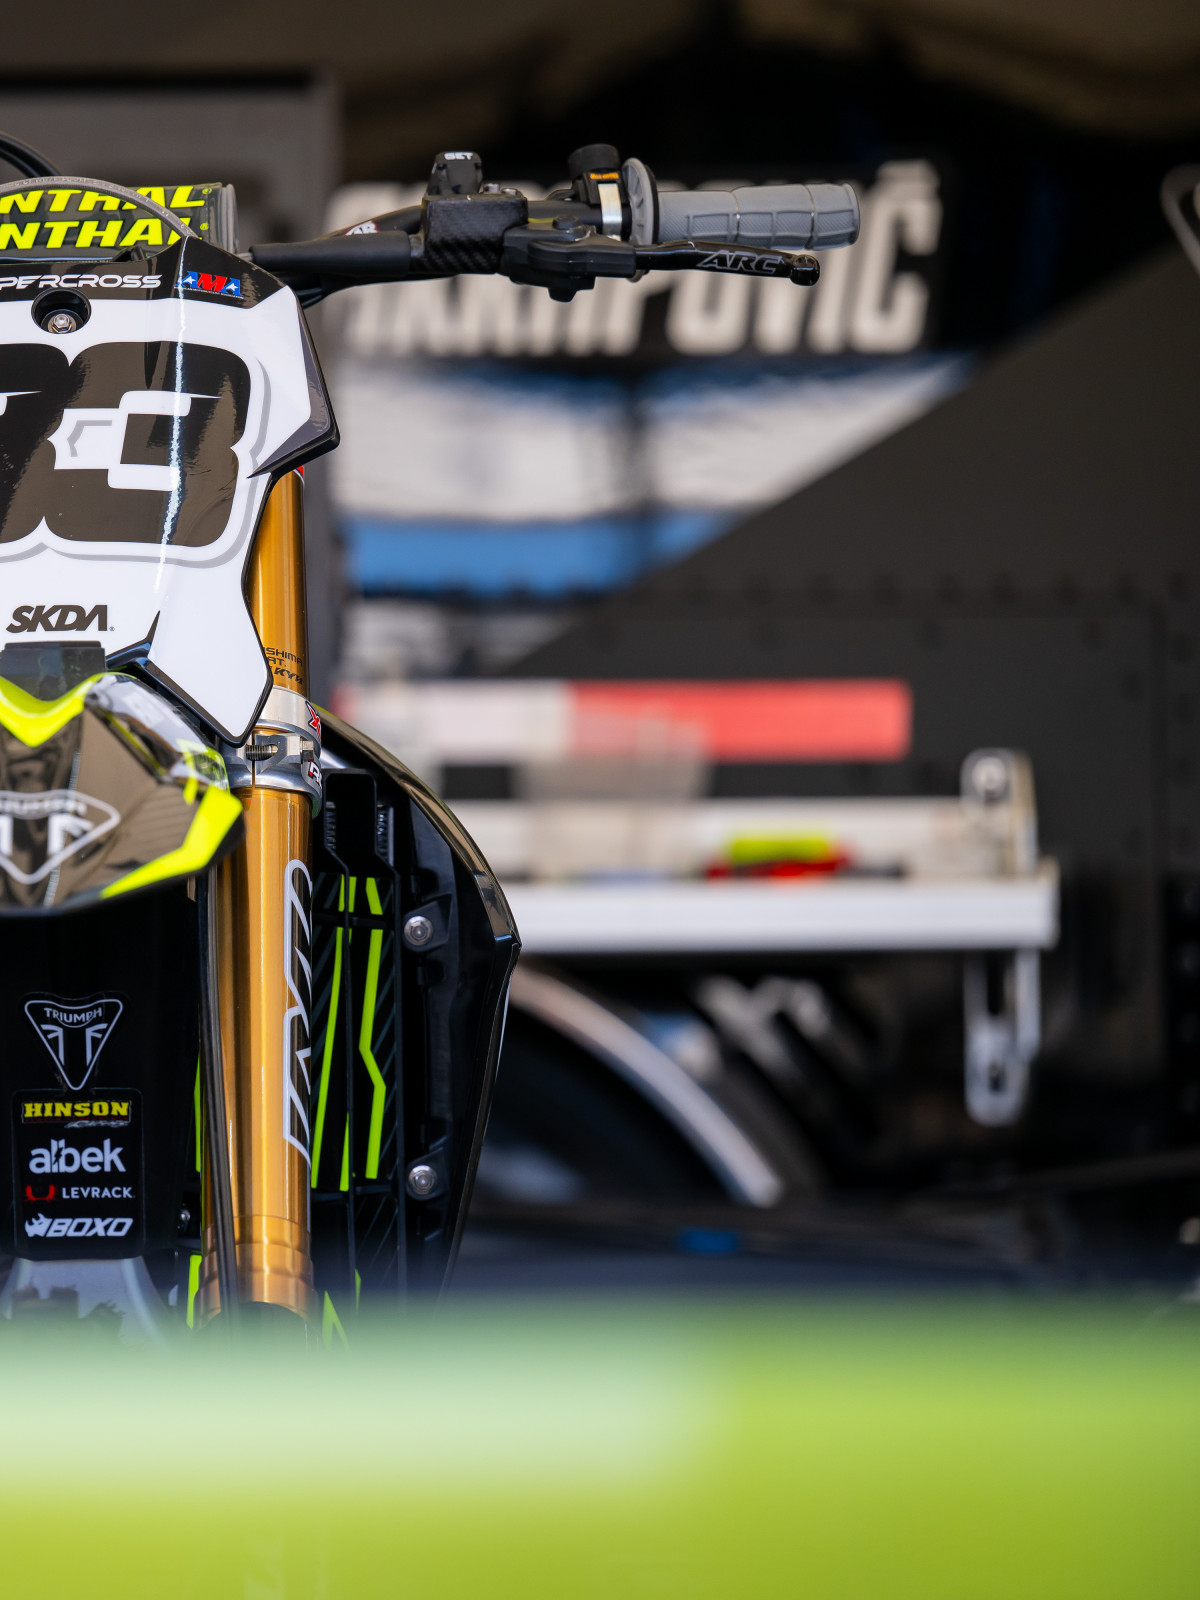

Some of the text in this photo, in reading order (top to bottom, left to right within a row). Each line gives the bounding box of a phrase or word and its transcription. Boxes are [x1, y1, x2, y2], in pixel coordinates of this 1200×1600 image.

[696, 249, 783, 275] ARC
[175, 269, 244, 297] AMA
[6, 604, 108, 633] SKDA
[43, 1007, 103, 1024] TRIUMPH
[23, 1101, 129, 1118] HINSON
[62, 1186, 133, 1199] LEVRACK
[46, 1217, 134, 1238] BOXO
